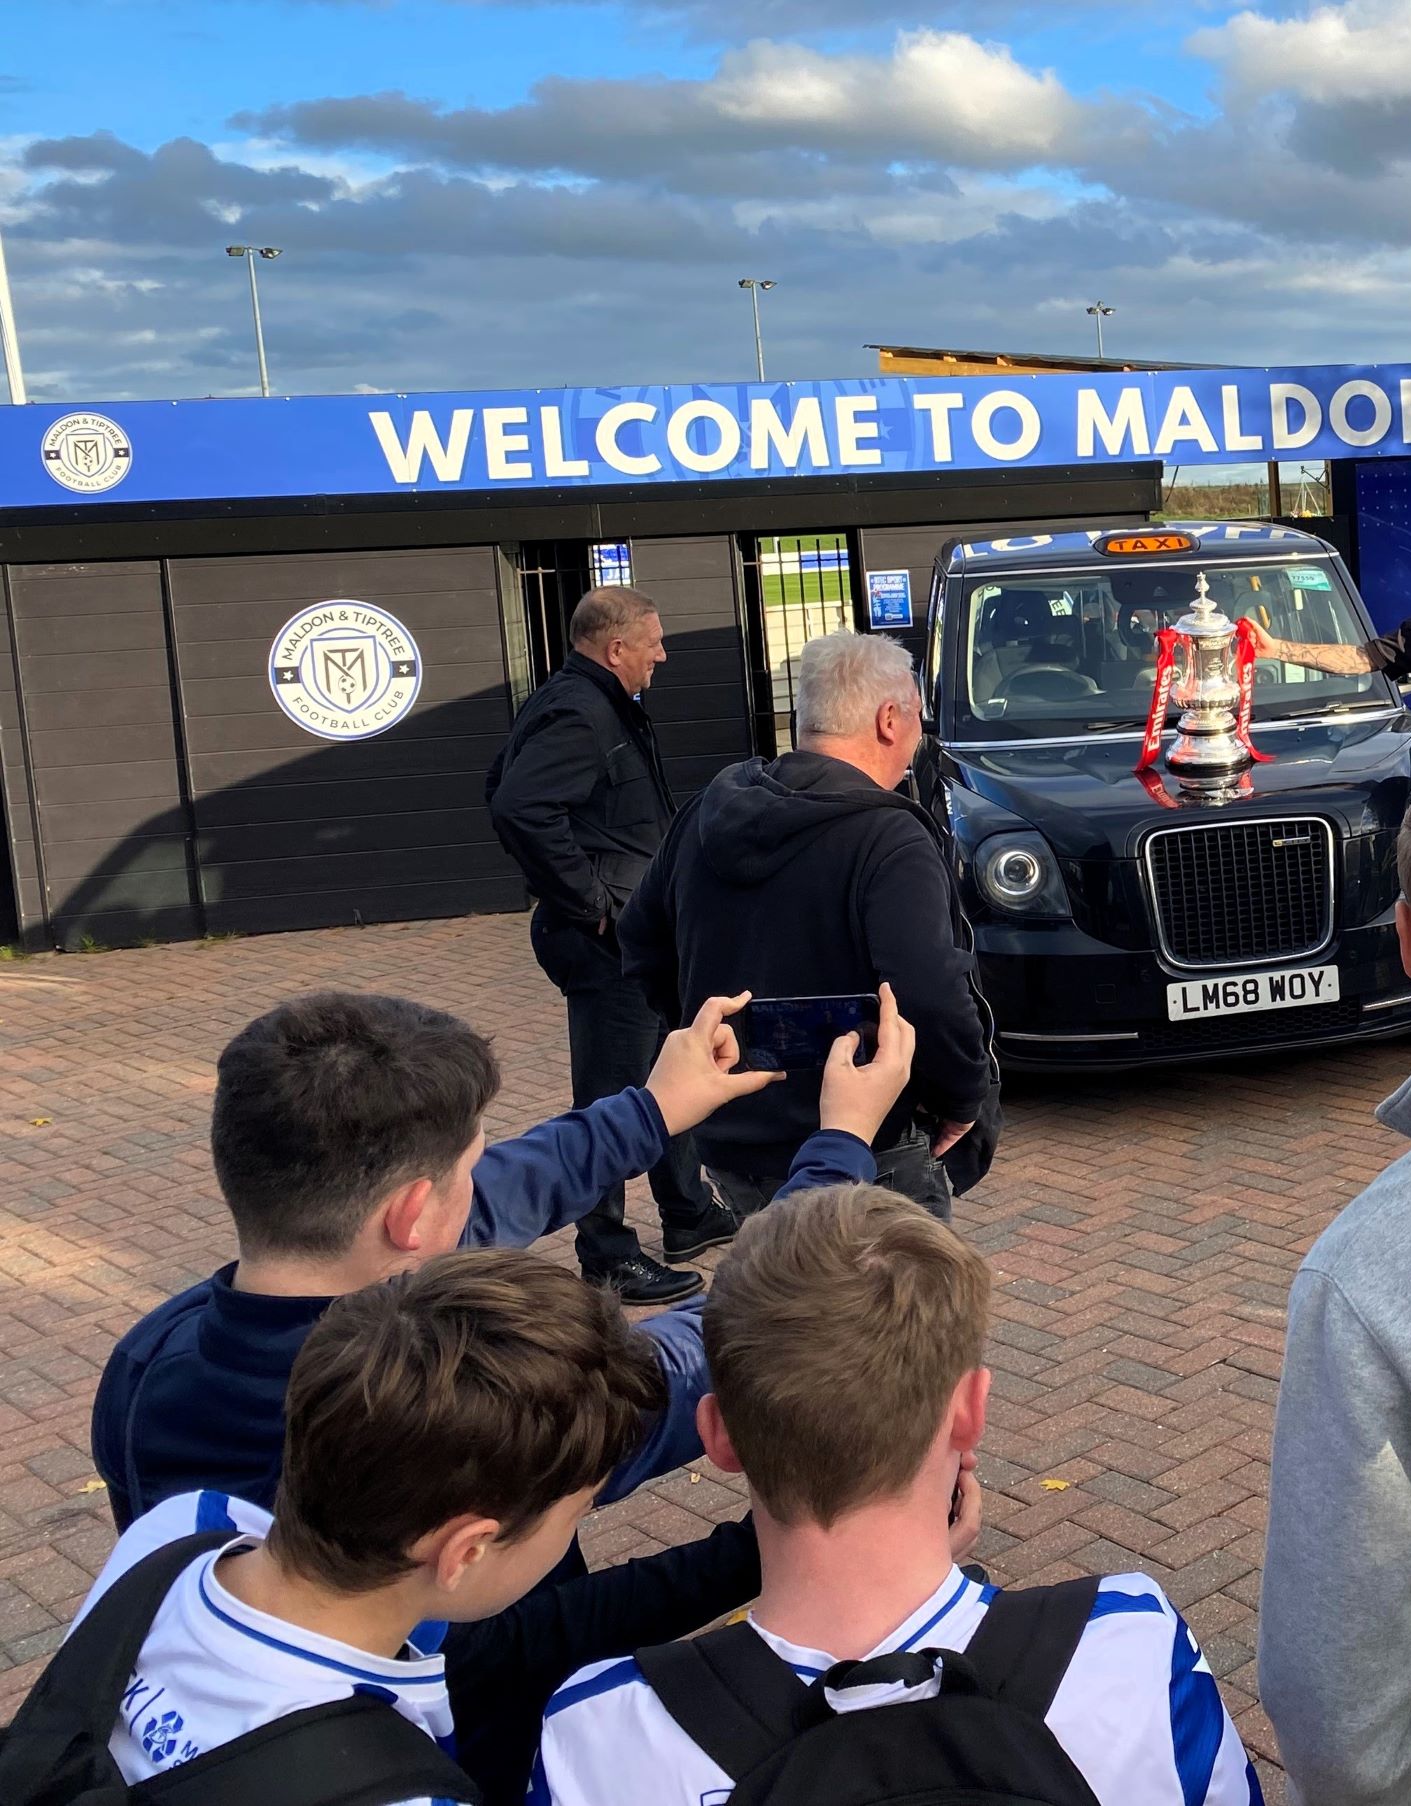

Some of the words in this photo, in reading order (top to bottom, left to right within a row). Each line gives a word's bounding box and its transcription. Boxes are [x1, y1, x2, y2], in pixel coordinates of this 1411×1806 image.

[49, 419, 80, 447] MALDON
[91, 418, 122, 445] TIPTREE
[368, 395, 882, 484] WELCOME
[914, 390, 1040, 462] TO
[55, 467, 101, 487] FOOTBALL
[104, 465, 122, 483] CLUB
[1114, 538, 1184, 551] TAXI
[282, 611, 335, 660] MALDON
[339, 610, 349, 621] &
[353, 611, 405, 656] TIPTREE
[292, 696, 370, 729] FOOTBALL
[374, 690, 404, 721] CLUB
[1147, 665, 1172, 752] Emirates
[1240, 662, 1253, 737] mirates
[1181, 978, 1260, 1013] LM68
[1268, 970, 1325, 1003] WOY
